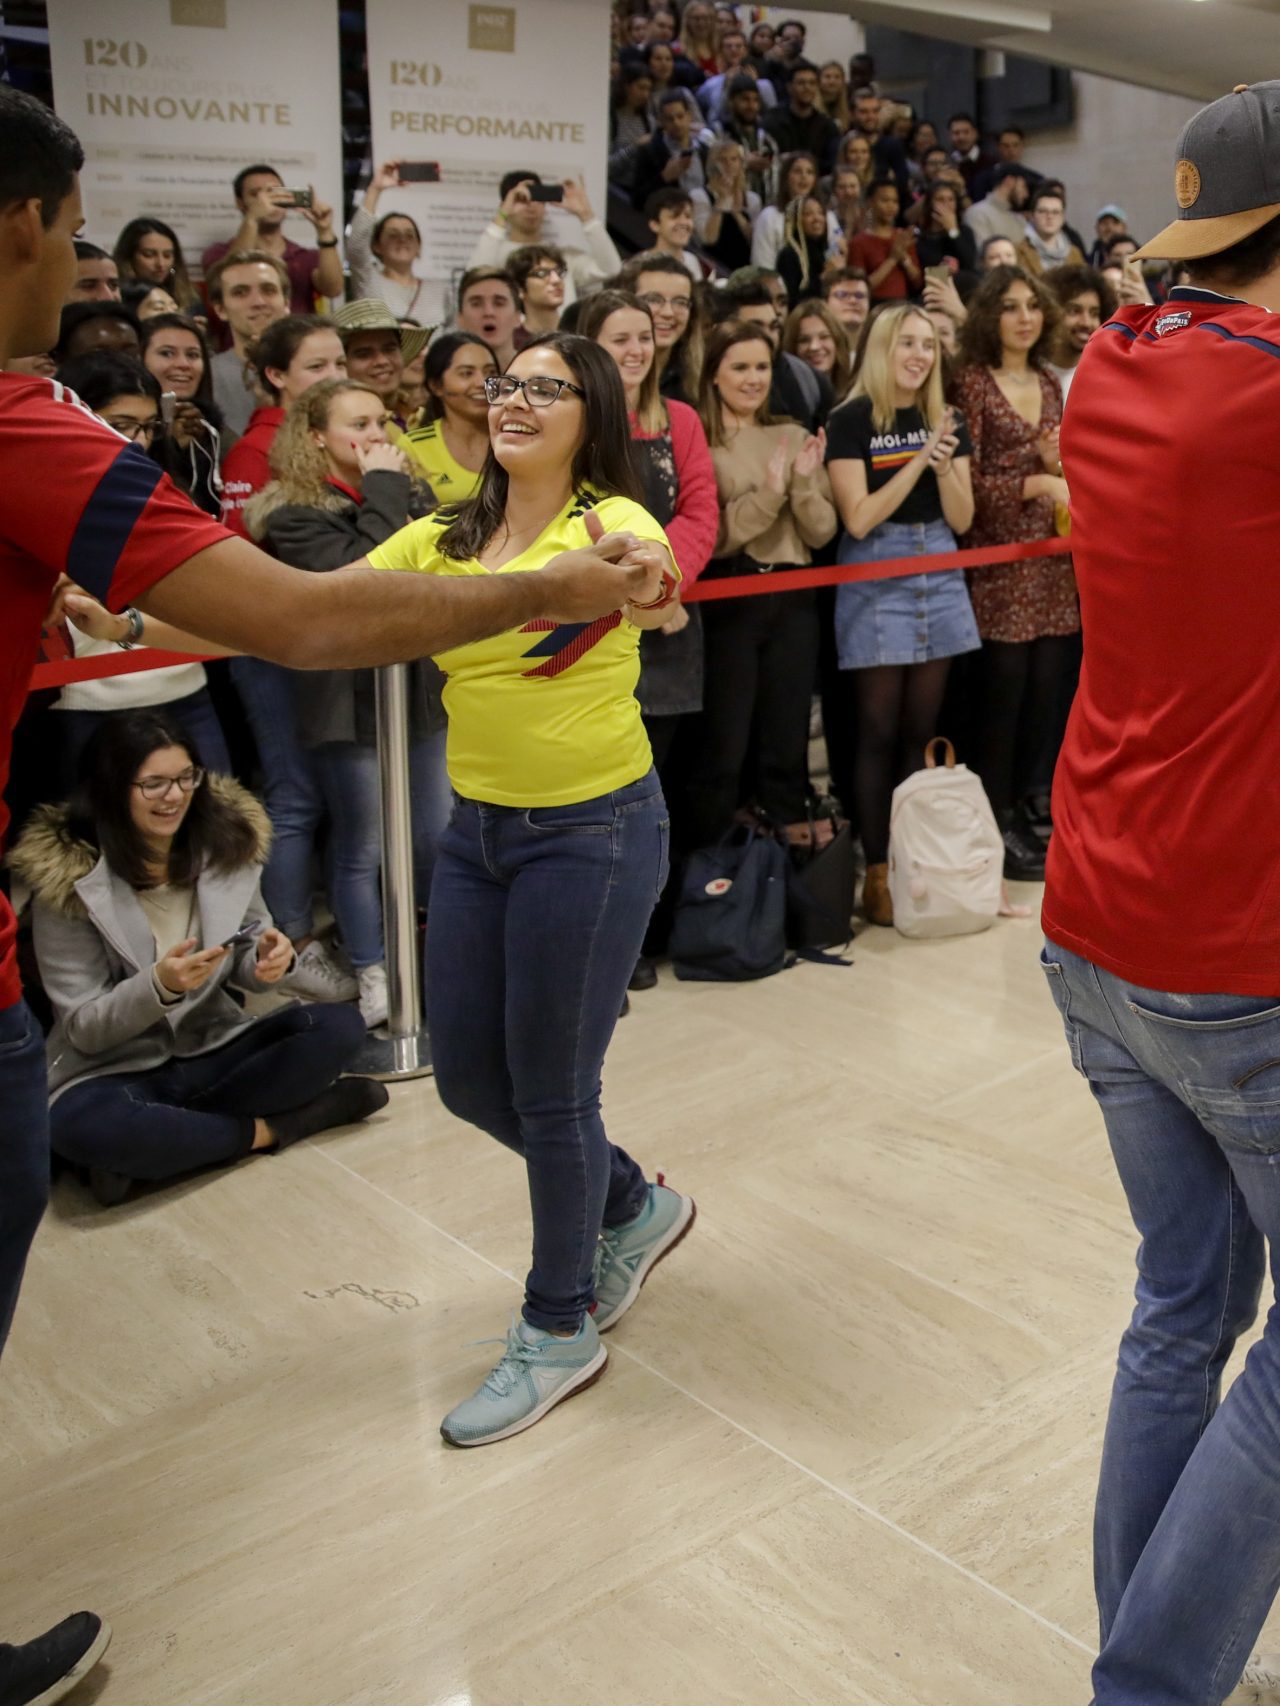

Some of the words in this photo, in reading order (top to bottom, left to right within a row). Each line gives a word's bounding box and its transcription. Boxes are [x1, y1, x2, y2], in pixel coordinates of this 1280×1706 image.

[83, 37, 148, 68] 120
[150, 54, 194, 73] ANS
[86, 74, 108, 90] ET
[116, 75, 224, 98] TOUJOURS
[389, 59, 443, 87] 120
[86, 92, 292, 126] INNOVANTE
[389, 110, 585, 144] PERFORMANTE
